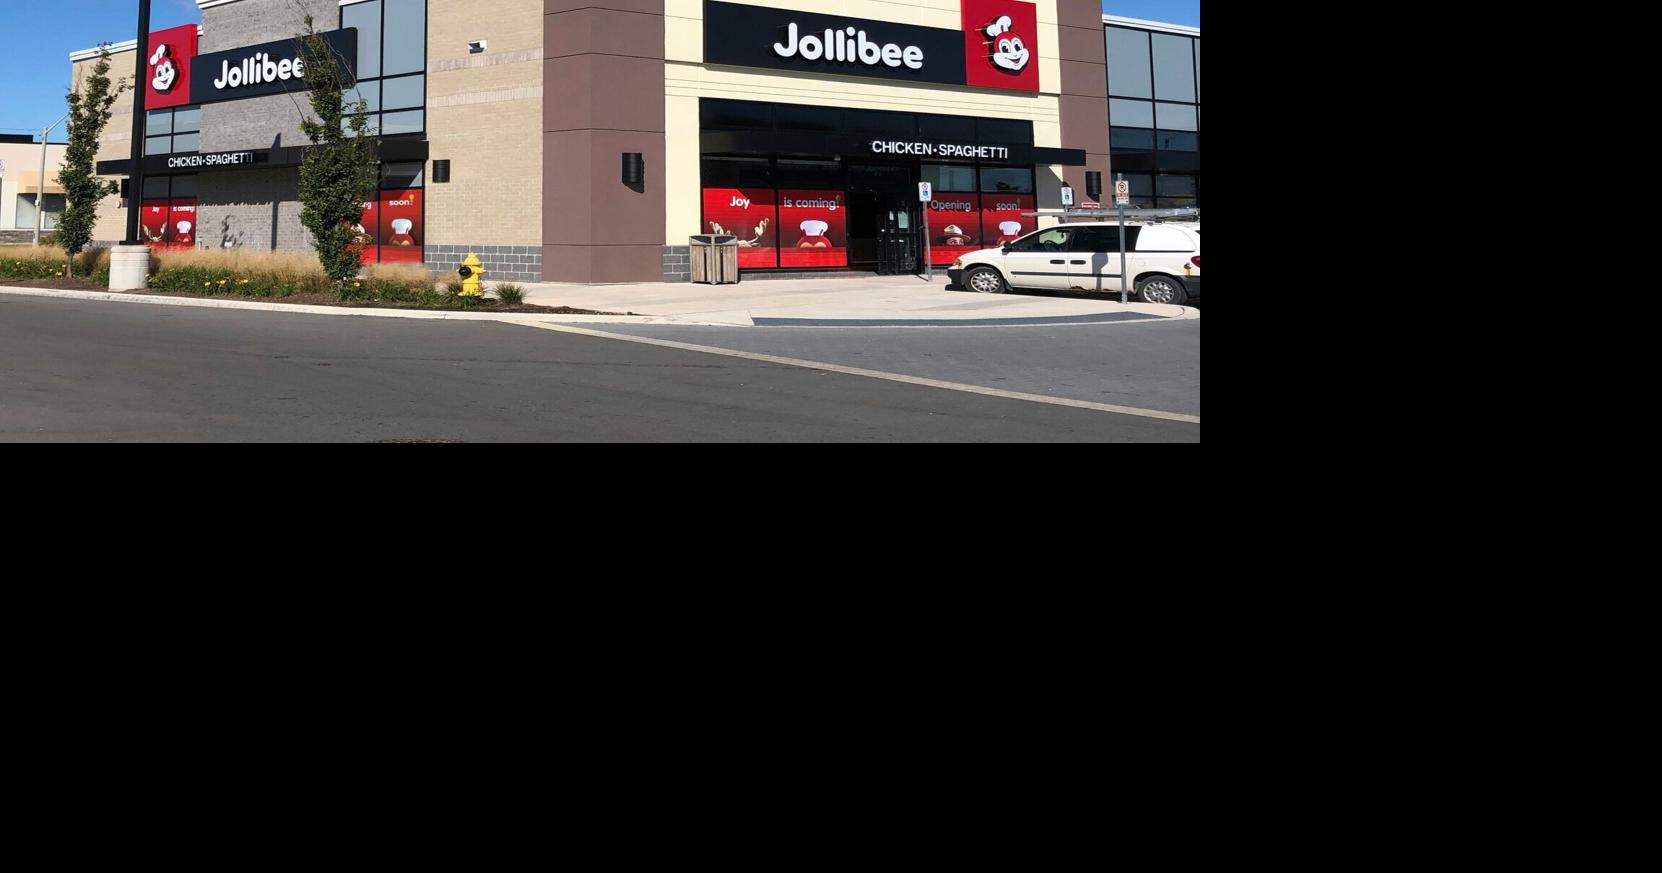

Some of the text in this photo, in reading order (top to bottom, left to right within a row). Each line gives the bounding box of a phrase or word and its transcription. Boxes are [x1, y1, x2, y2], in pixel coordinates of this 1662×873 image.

[773, 22, 924, 69] Jollibee
[729, 196, 750, 209] Joy
[783, 196, 793, 208] is
[930, 200, 972, 212] Opening
